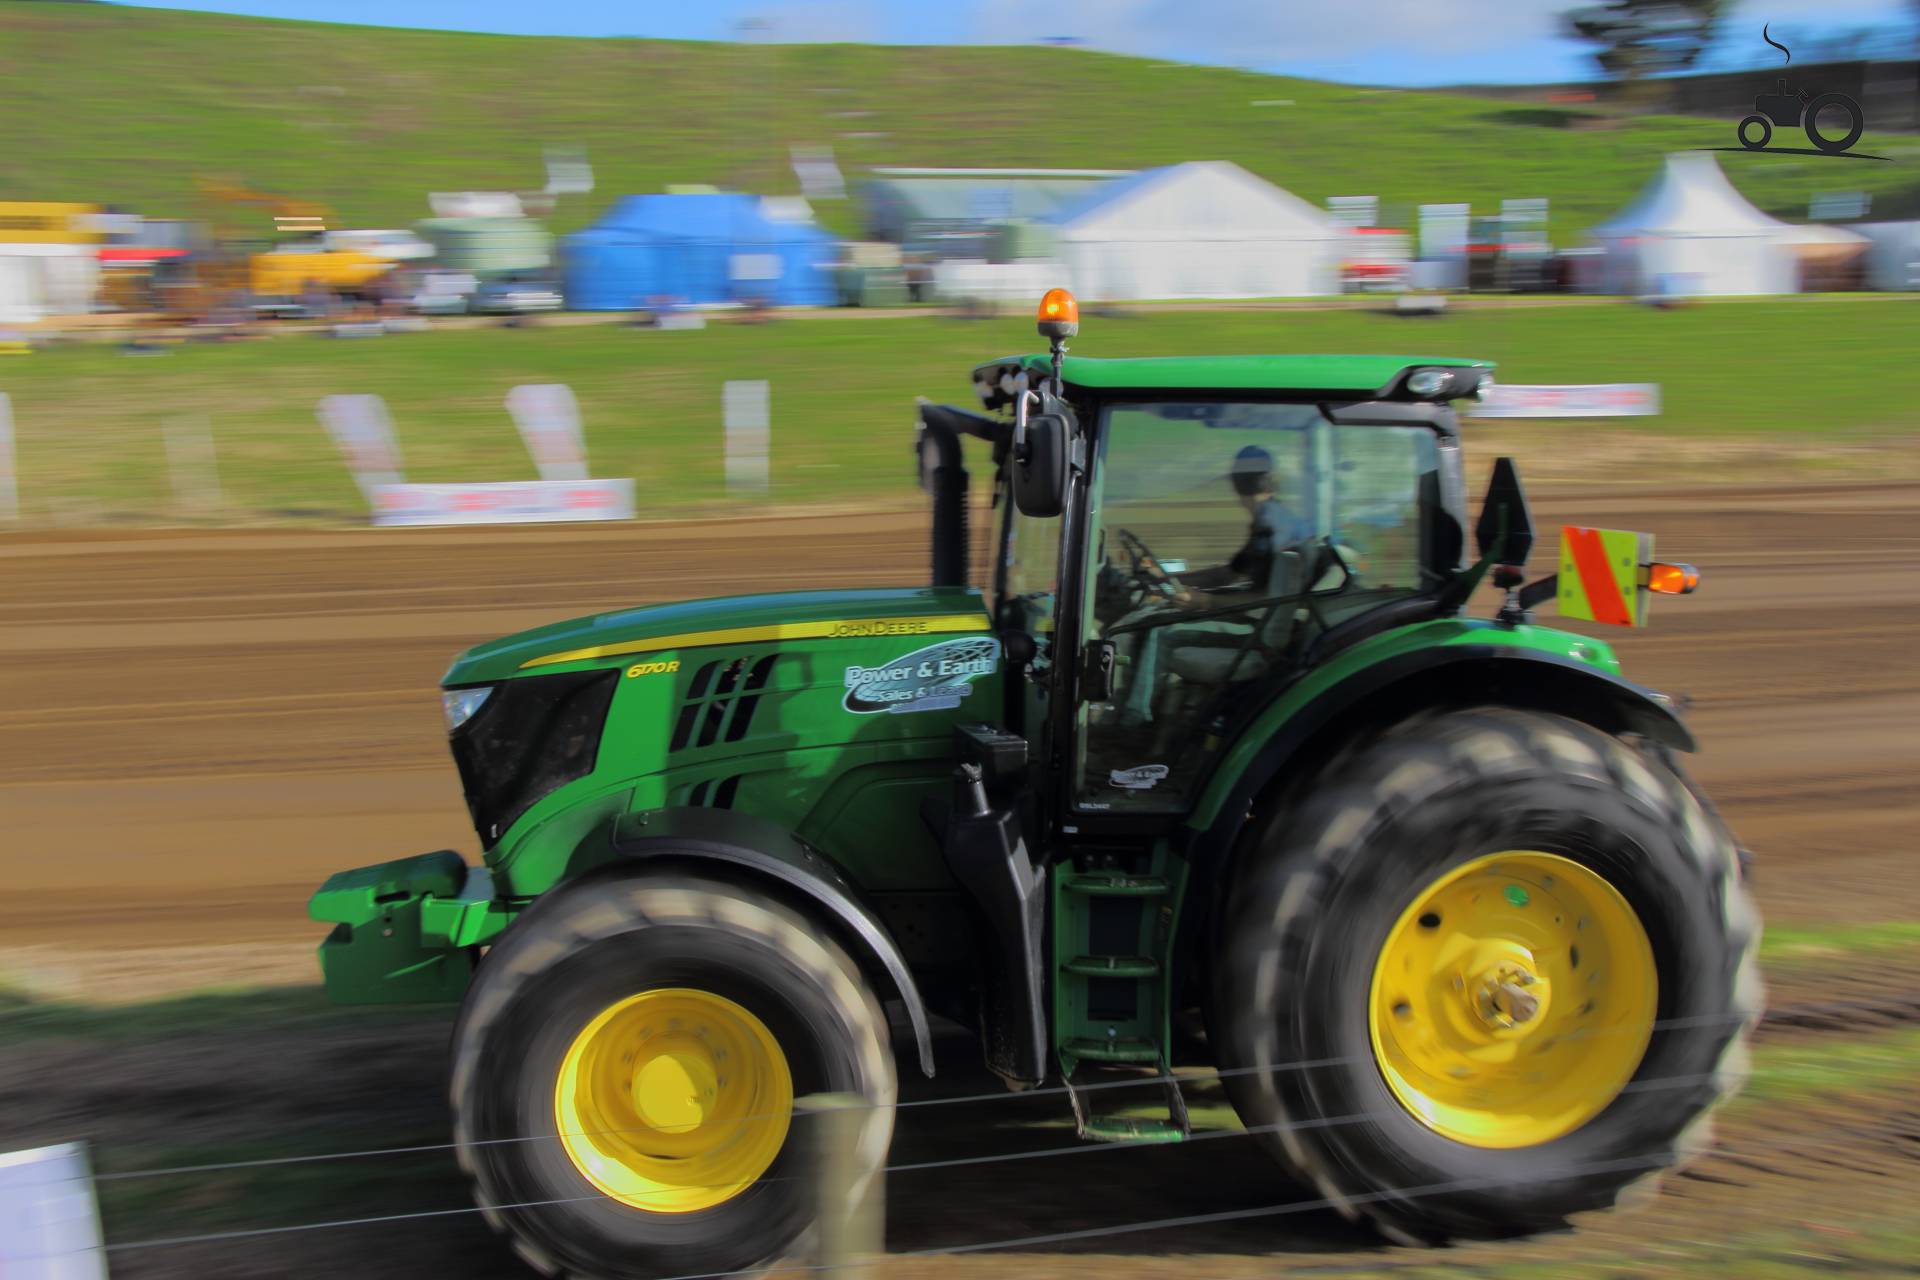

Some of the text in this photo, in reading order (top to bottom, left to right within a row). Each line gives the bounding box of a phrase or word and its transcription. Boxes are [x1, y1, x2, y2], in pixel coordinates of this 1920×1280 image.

[829, 621, 928, 636] JOHN DEERE
[848, 658, 992, 684] Power & Earth
[879, 689, 913, 702] Sales
